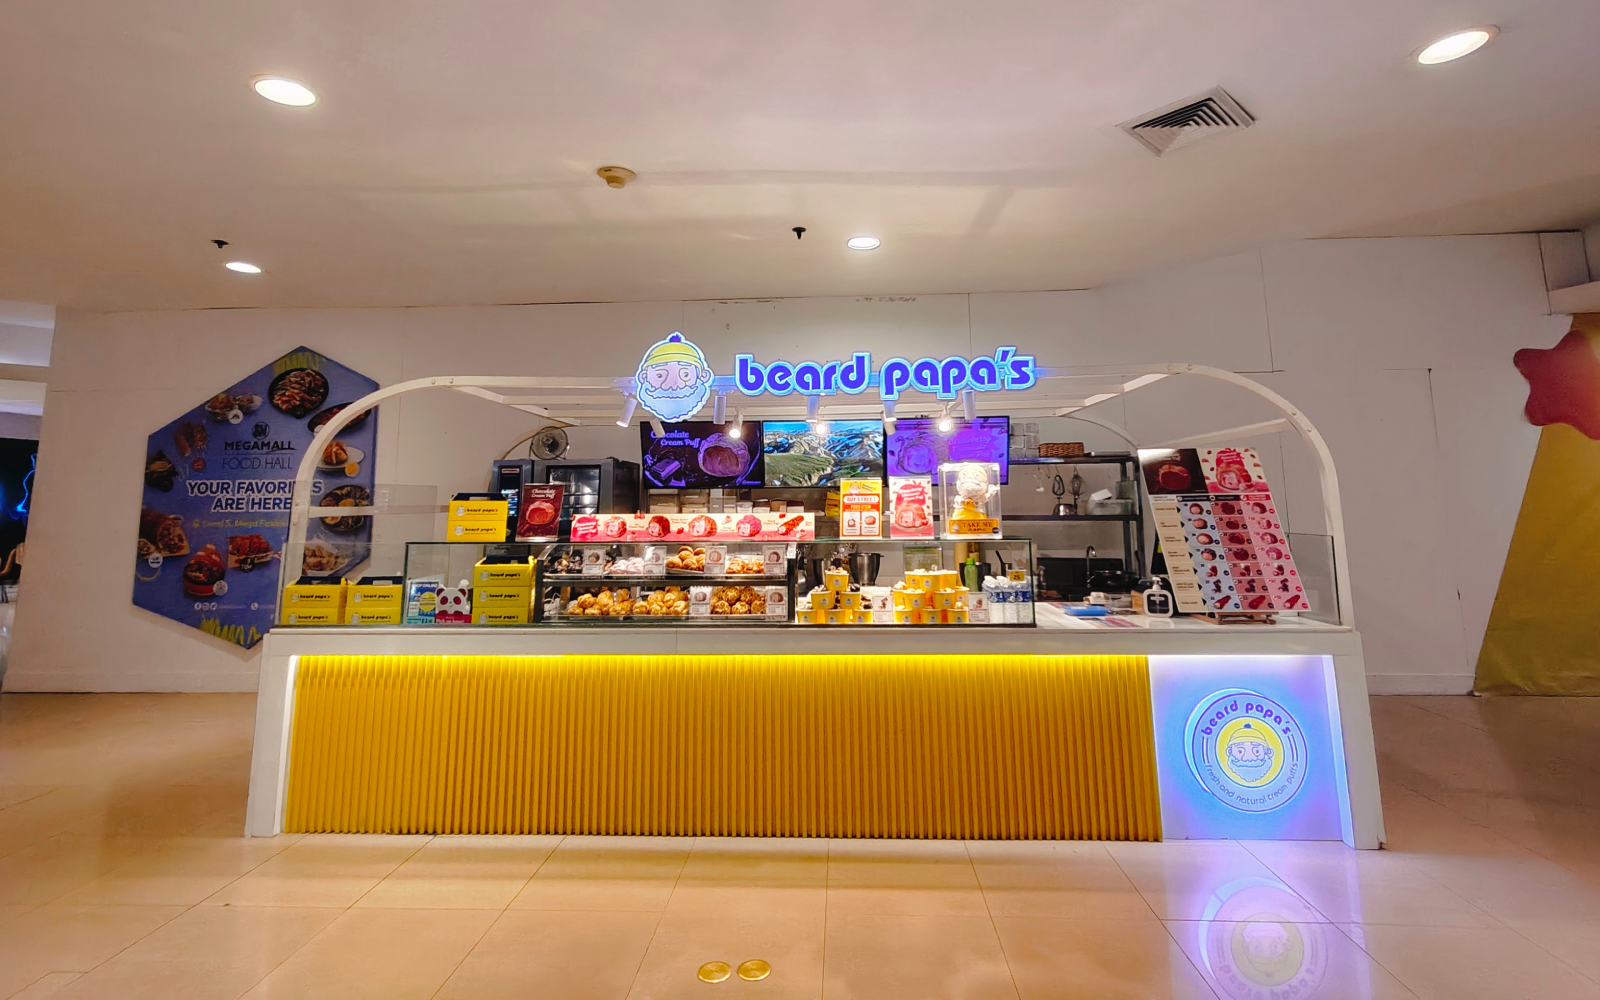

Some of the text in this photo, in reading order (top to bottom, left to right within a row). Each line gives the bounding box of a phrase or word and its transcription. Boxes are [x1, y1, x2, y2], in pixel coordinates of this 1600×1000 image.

[737, 348, 1031, 398] beard papa's
[650, 430, 690, 439] Ccolate
[224, 441, 295, 451] MEGAMALL
[660, 437, 701, 448] Cream Puff
[222, 457, 292, 470] FOOD HALL
[187, 480, 323, 496] YOUR FAVORIS
[212, 497, 246, 511] ARE
[1201, 700, 1292, 736] beard papa's
[1205, 762, 1299, 805] fresh and natural cream puffs
